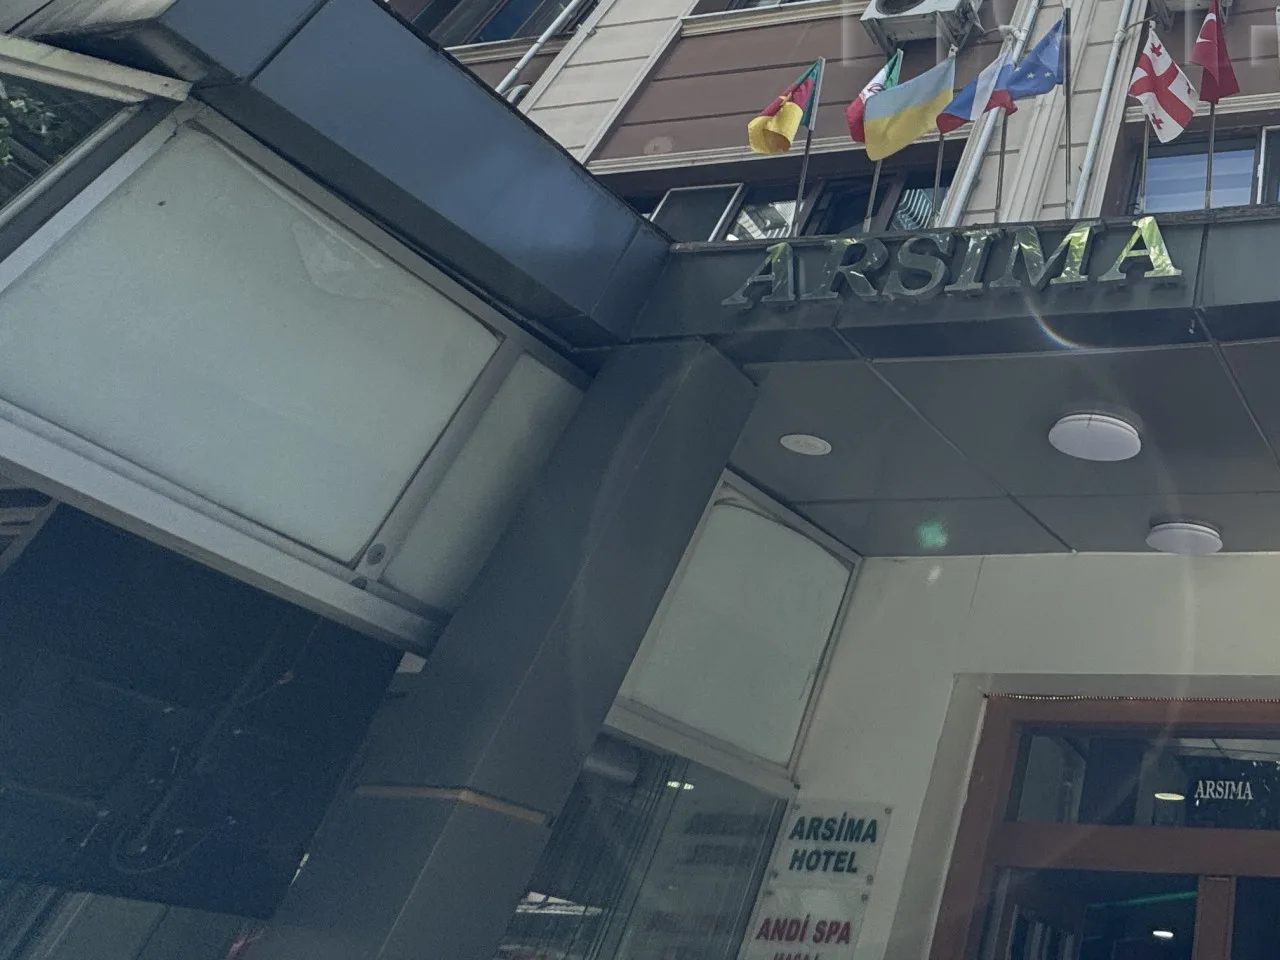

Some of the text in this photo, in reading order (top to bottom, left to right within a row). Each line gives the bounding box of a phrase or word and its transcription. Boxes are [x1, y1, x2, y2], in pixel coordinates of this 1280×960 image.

[721, 217, 1184, 308] ARSIMA
[1194, 779, 1253, 801] ARSIMA
[789, 812, 878, 843] ARSİMA
[790, 850, 858, 873] HOTEL
[755, 913, 852, 945] ANDİ SPA
